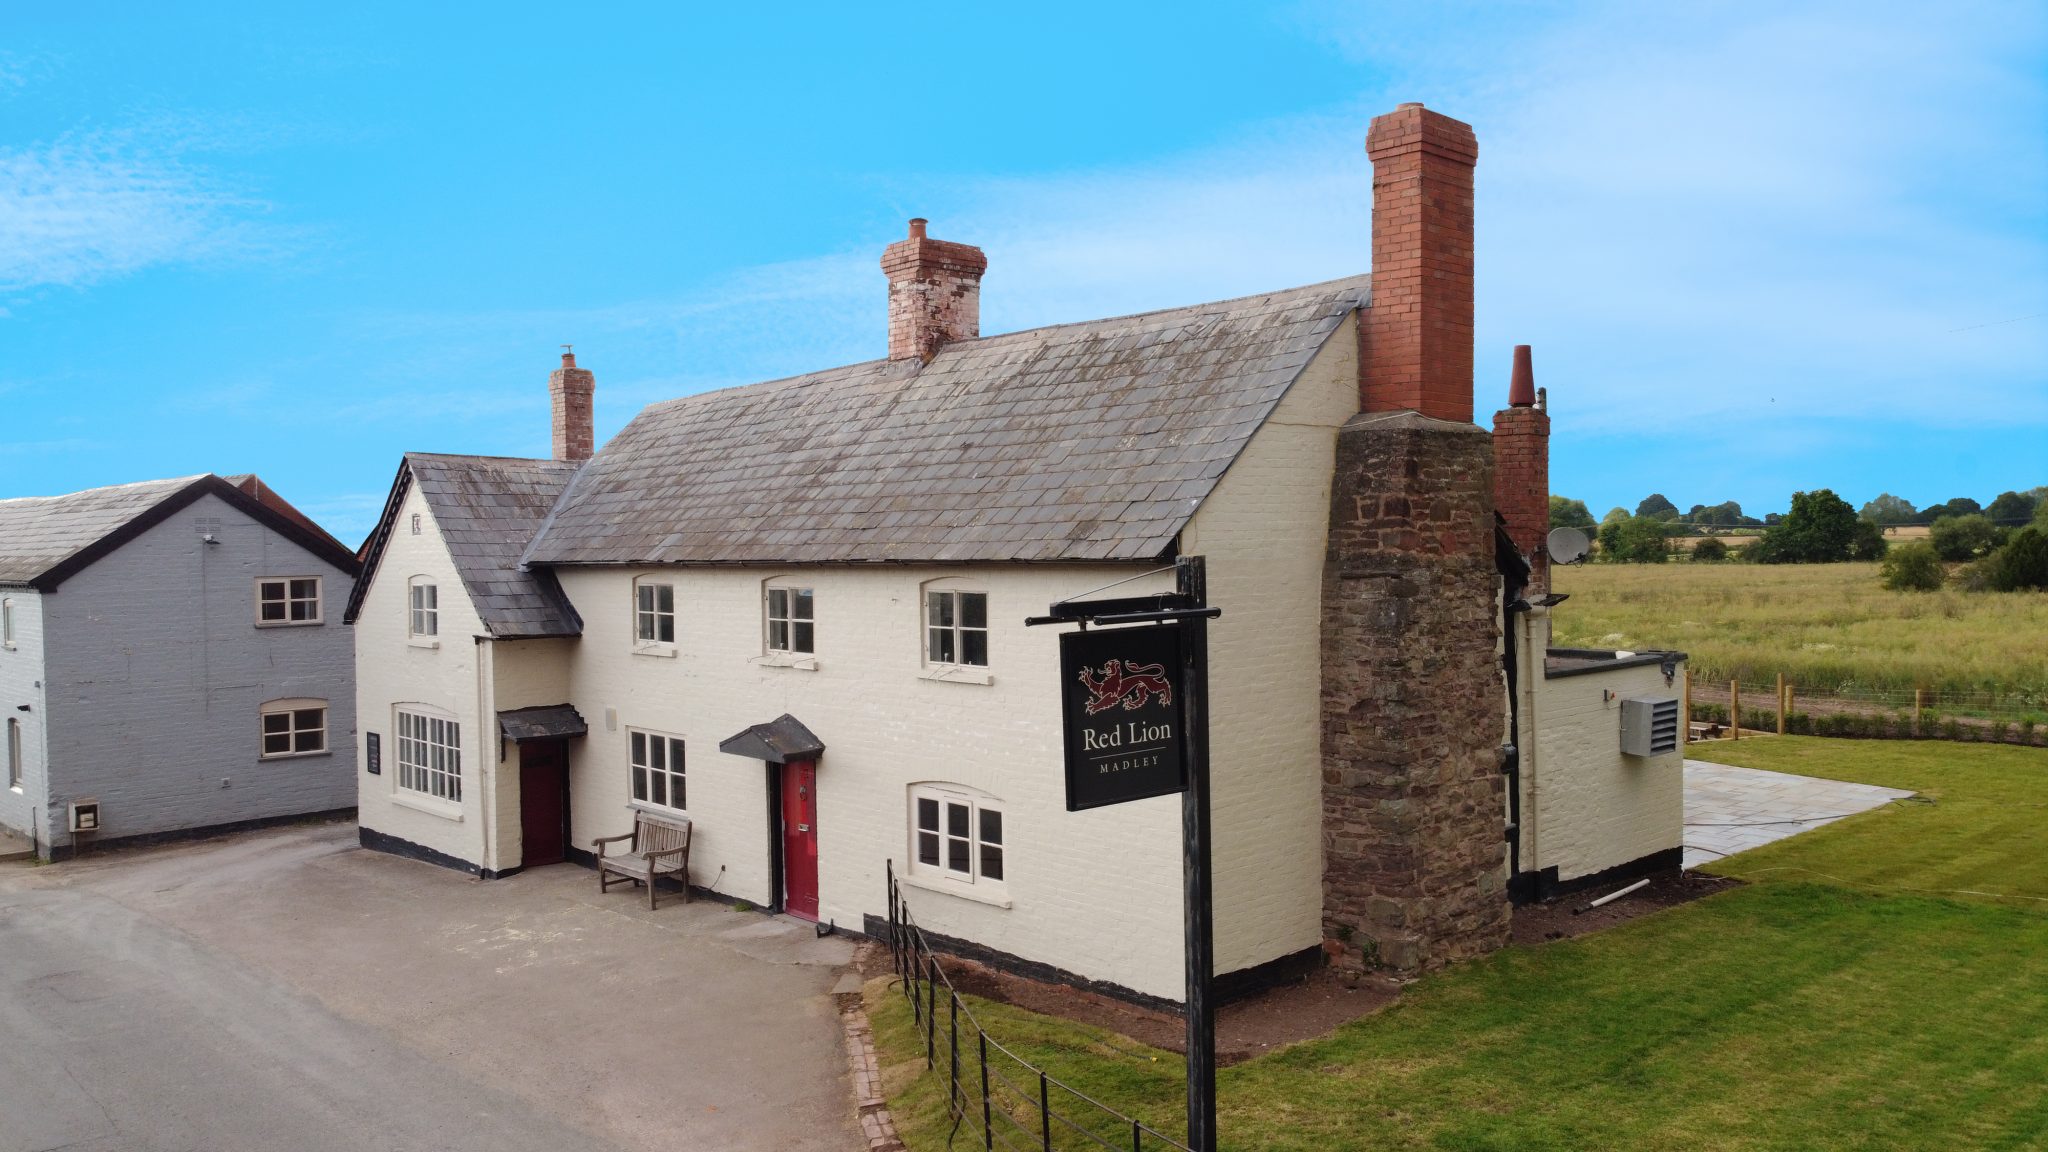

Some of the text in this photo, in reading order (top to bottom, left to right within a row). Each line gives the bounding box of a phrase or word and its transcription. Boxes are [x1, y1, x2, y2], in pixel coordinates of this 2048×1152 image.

[1083, 721, 1171, 751] Red Lion
[1100, 756, 1158, 774] MADLEY
